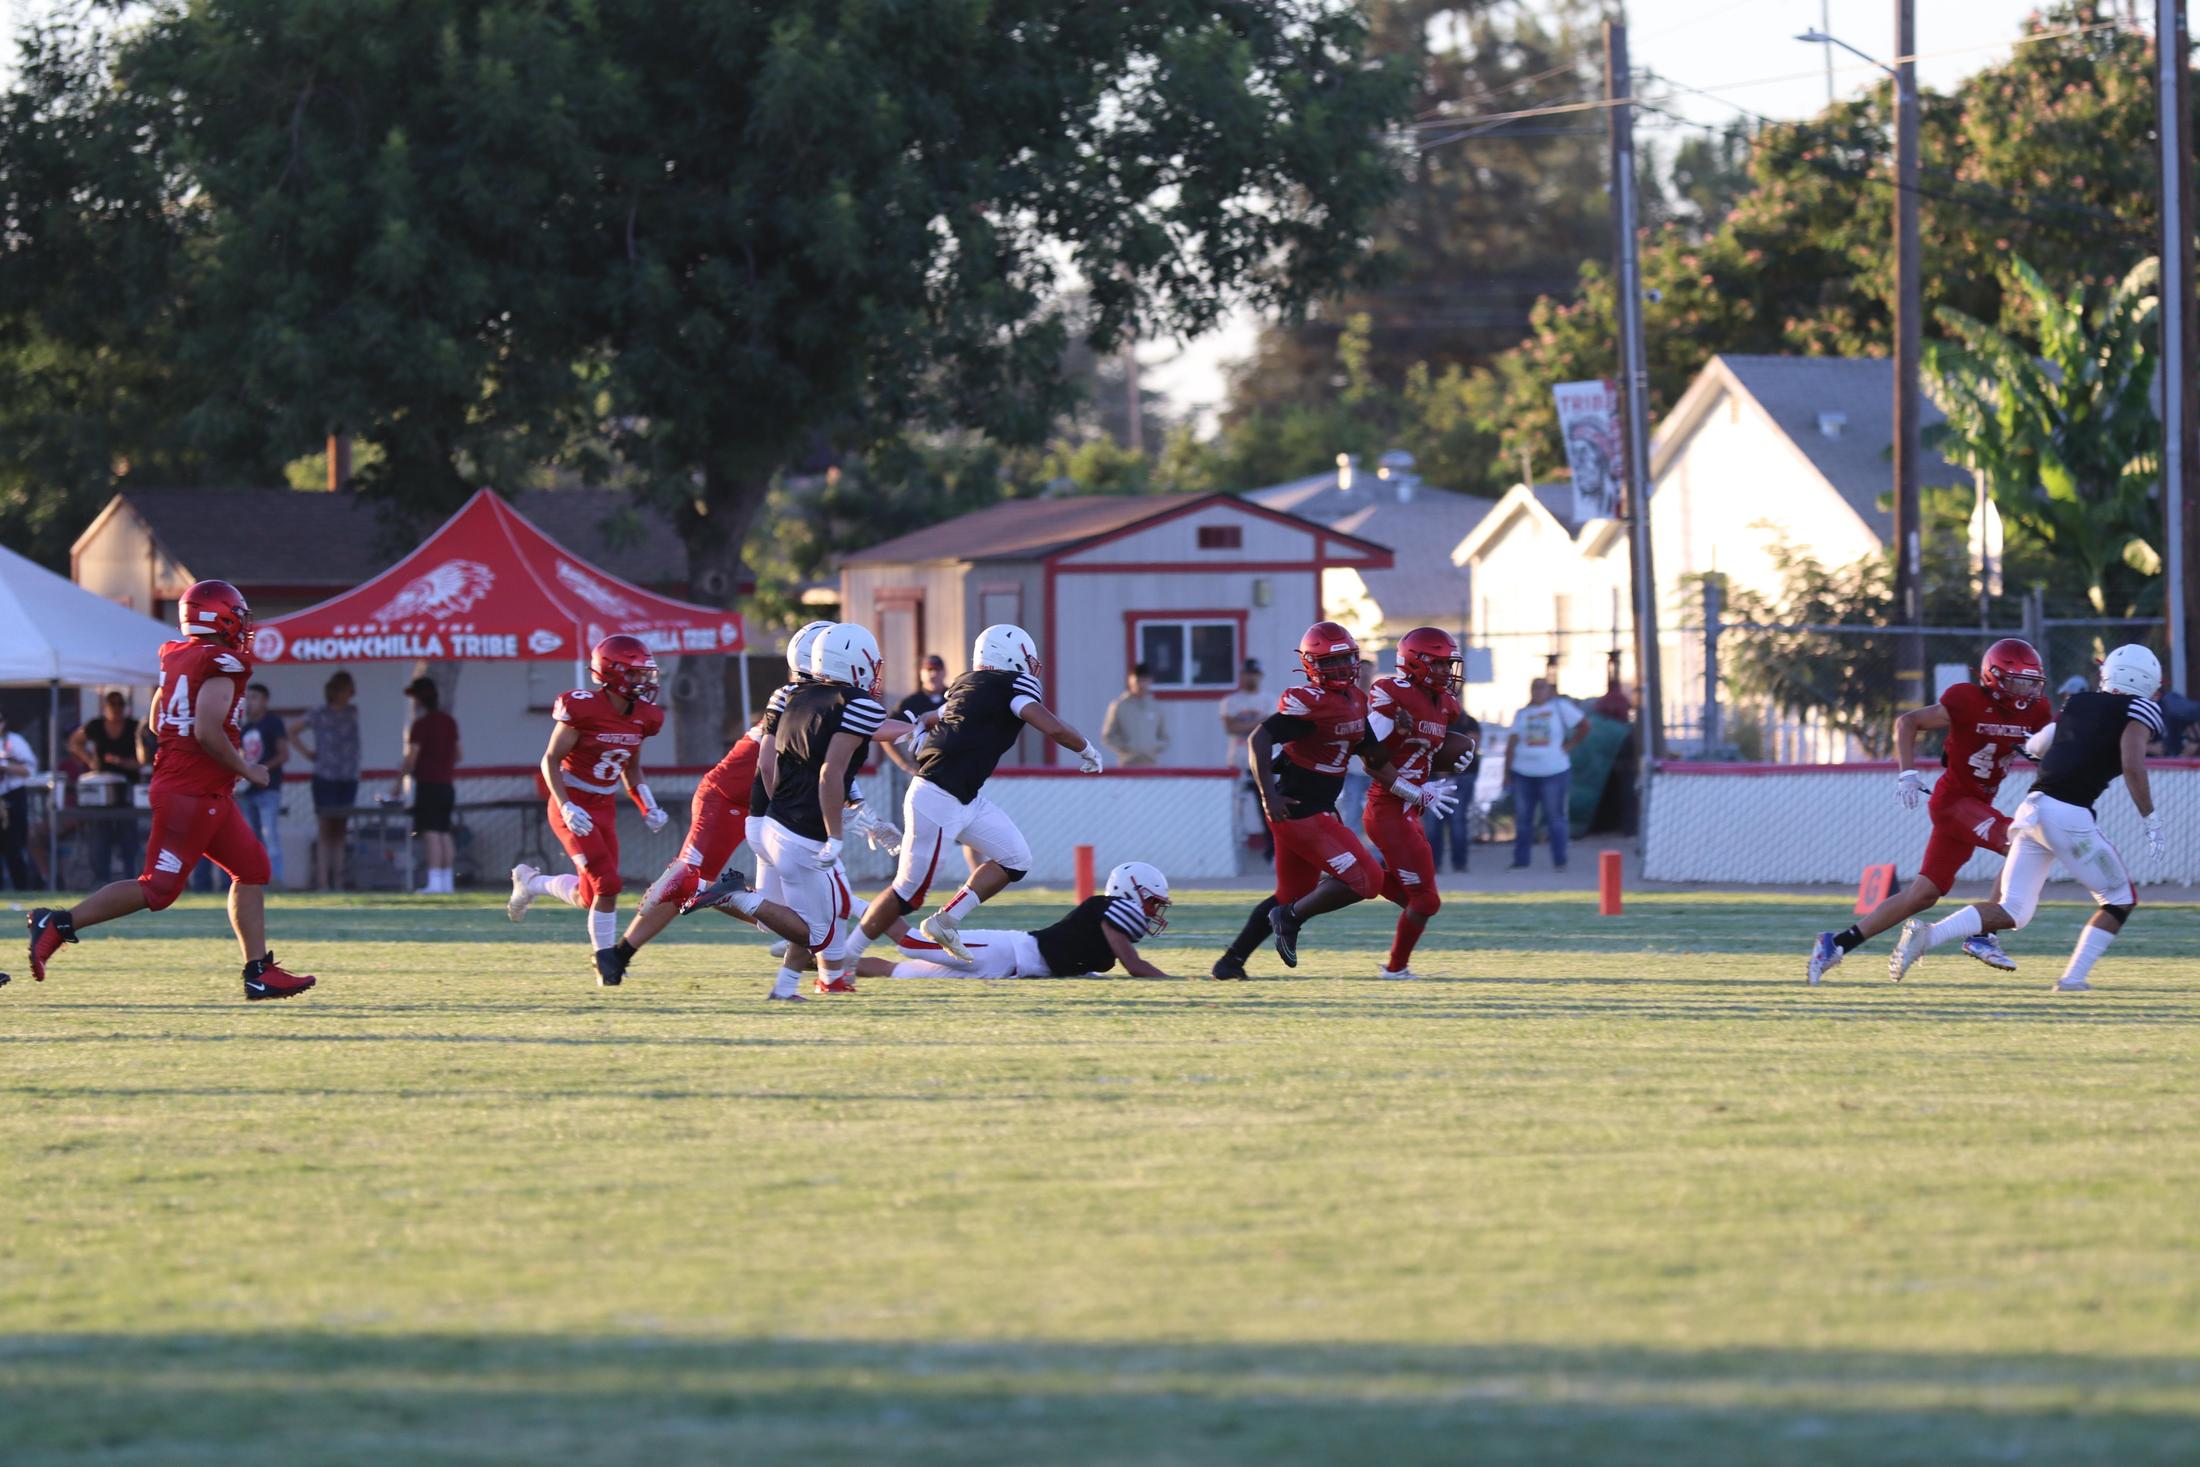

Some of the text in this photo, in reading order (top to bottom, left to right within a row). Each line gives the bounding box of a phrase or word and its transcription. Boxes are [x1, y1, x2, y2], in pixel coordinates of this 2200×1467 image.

[291, 632, 519, 660] CHOWCHILLA TRIBE
[593, 749, 632, 781] 8
